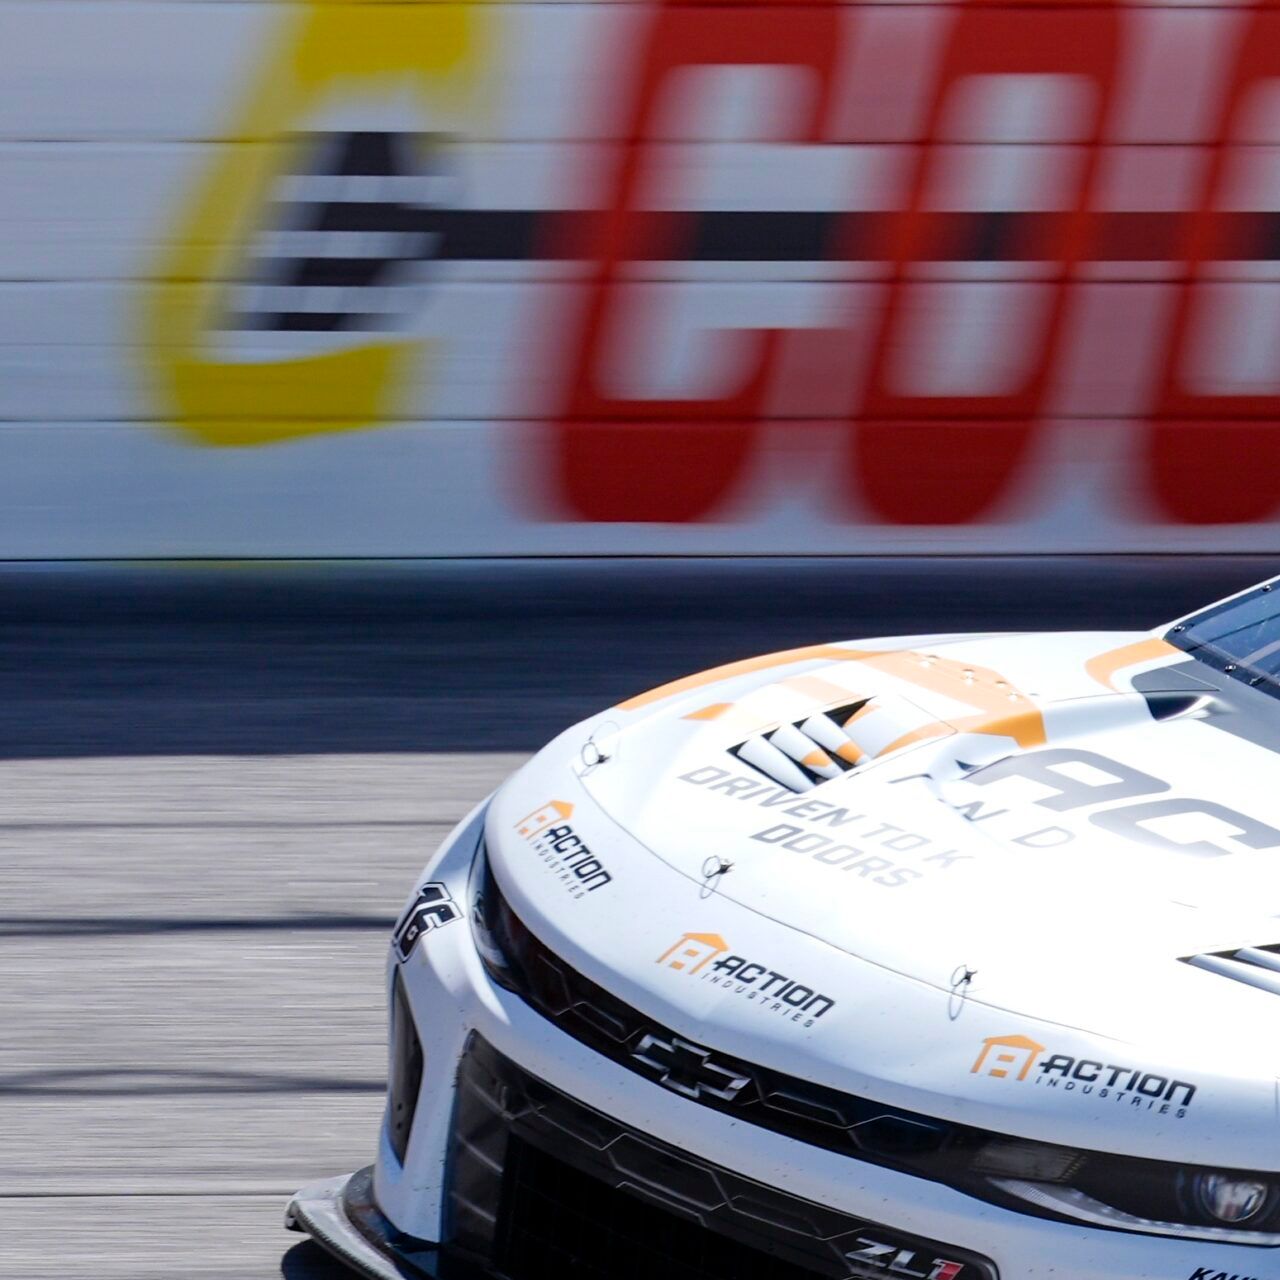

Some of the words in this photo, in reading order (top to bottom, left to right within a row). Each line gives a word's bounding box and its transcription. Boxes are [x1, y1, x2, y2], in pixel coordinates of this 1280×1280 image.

[543, 825, 612, 892] ACTION
[701, 973, 815, 1028] INDUSTRIES
[712, 955, 836, 1018] ACTION
[1035, 1075, 1187, 1119] INDUSTRIES
[1039, 1054, 1197, 1106] ACTION
